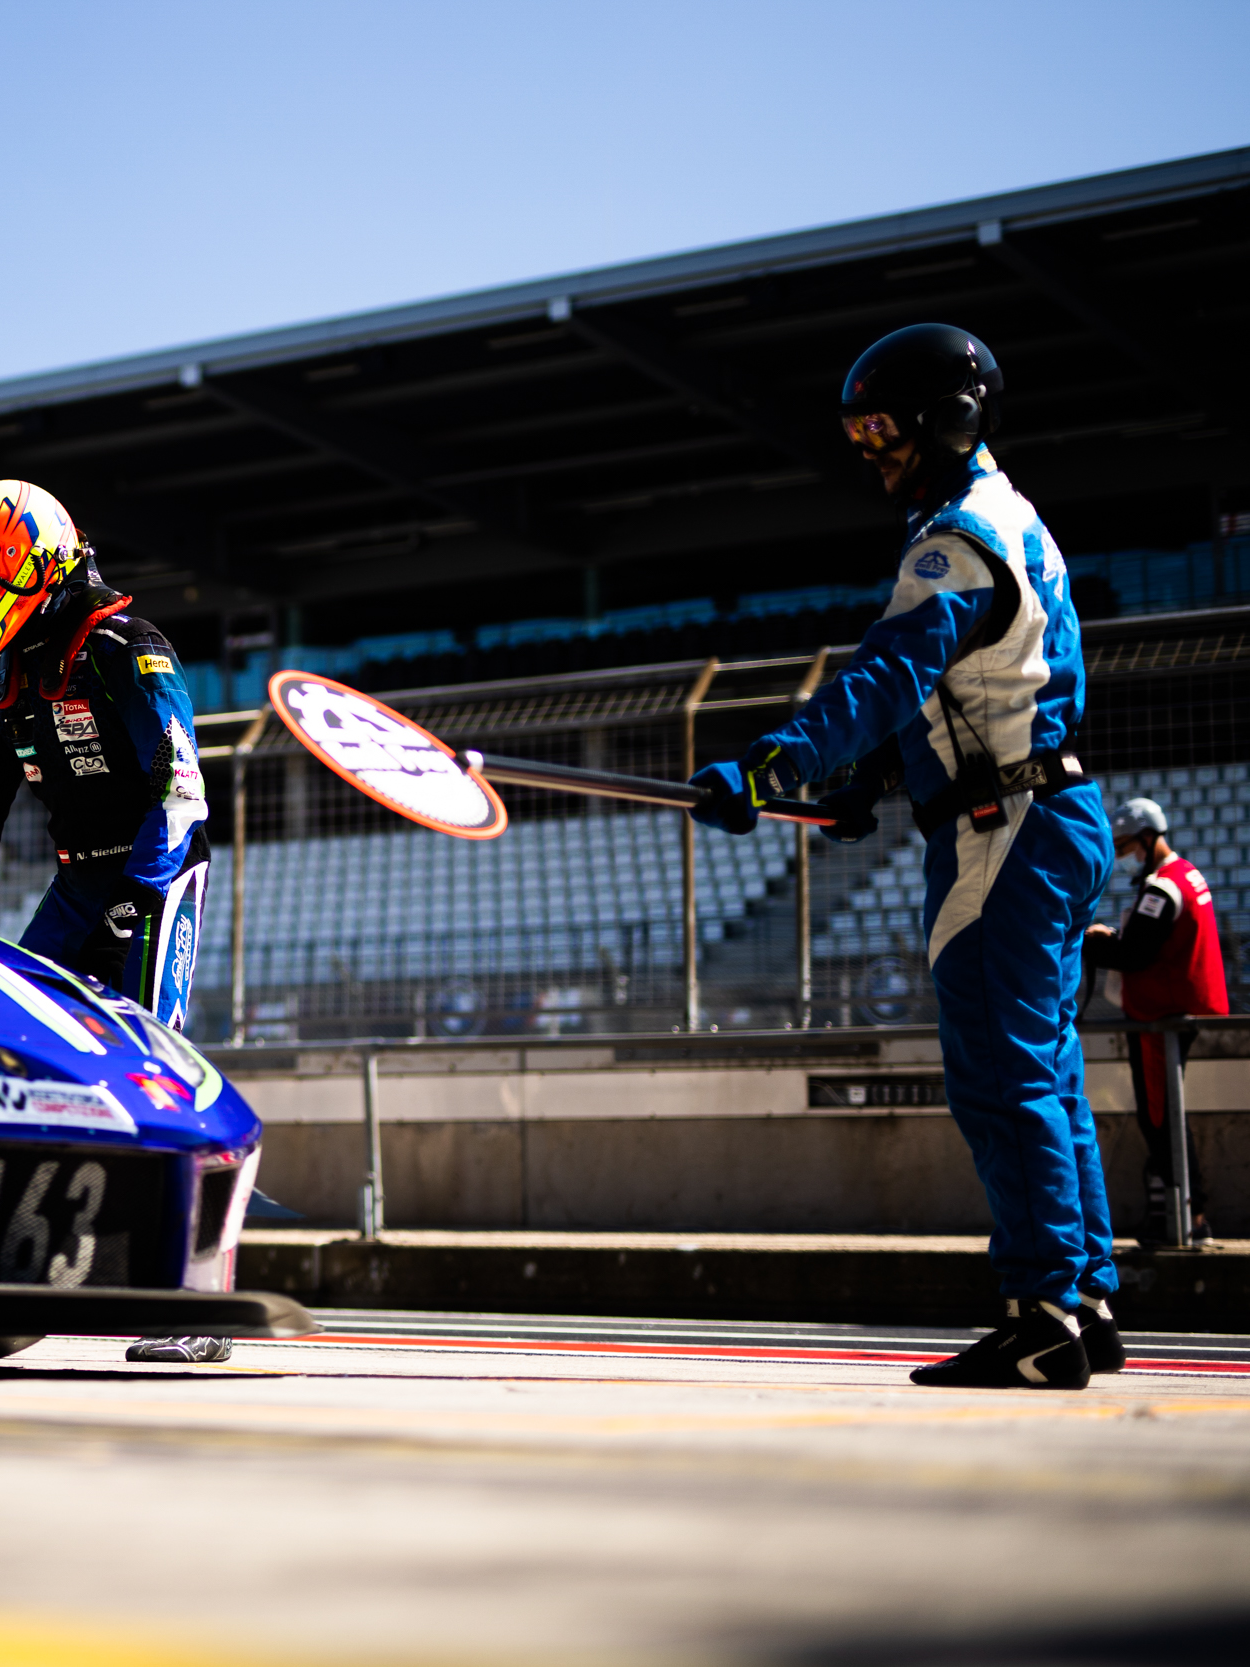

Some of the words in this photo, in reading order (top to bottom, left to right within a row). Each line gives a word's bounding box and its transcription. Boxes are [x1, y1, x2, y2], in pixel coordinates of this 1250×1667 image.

[145, 658, 171, 669] Hertz
[64, 703, 88, 711] TOTAL
[60, 720, 99, 739] SPA
[174, 768, 199, 780] KLATT
[76, 851, 88, 861] N.
[91, 844, 134, 858] Siedler
